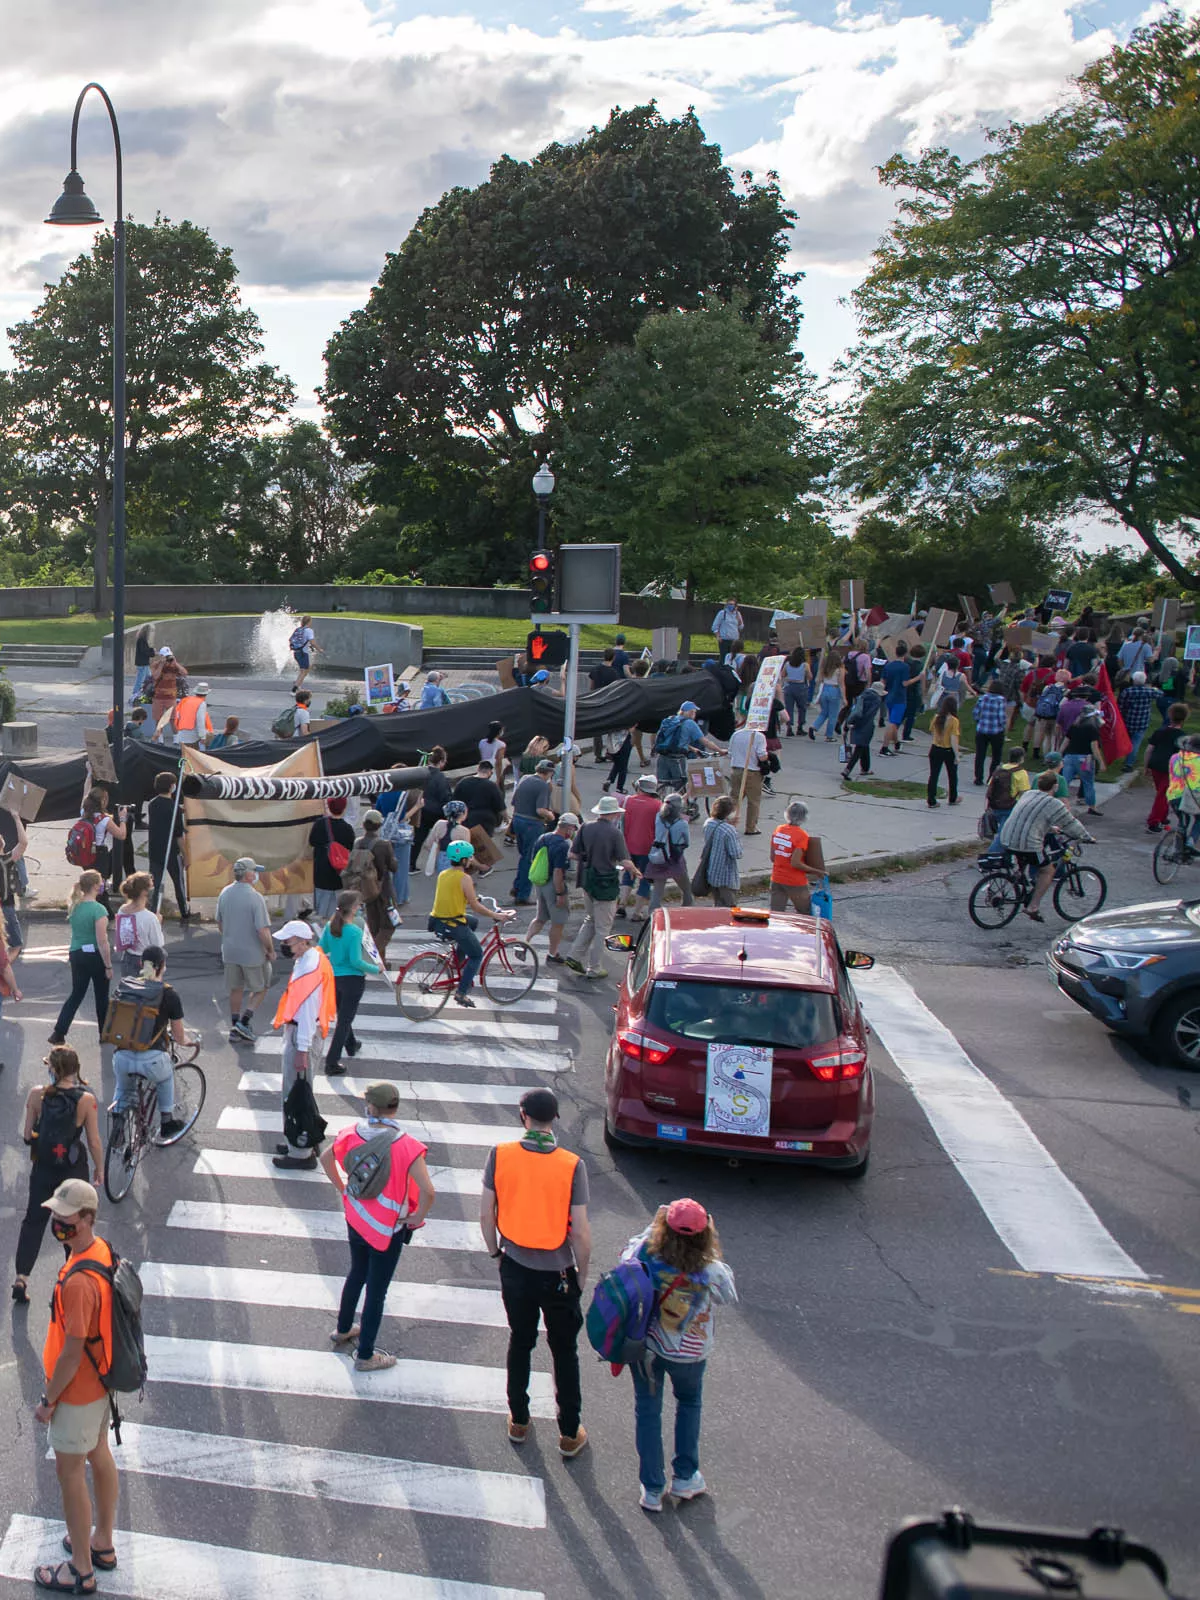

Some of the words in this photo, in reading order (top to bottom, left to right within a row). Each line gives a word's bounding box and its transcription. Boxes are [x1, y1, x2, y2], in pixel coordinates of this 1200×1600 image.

[218, 776, 244, 799] NO
[279, 779, 308, 800] FOR
[311, 777, 355, 799] FOSSIL
[358, 773, 393, 794] FUELS
[710, 1043, 736, 1052] STOP
[712, 1075, 752, 1097] SNAKE
